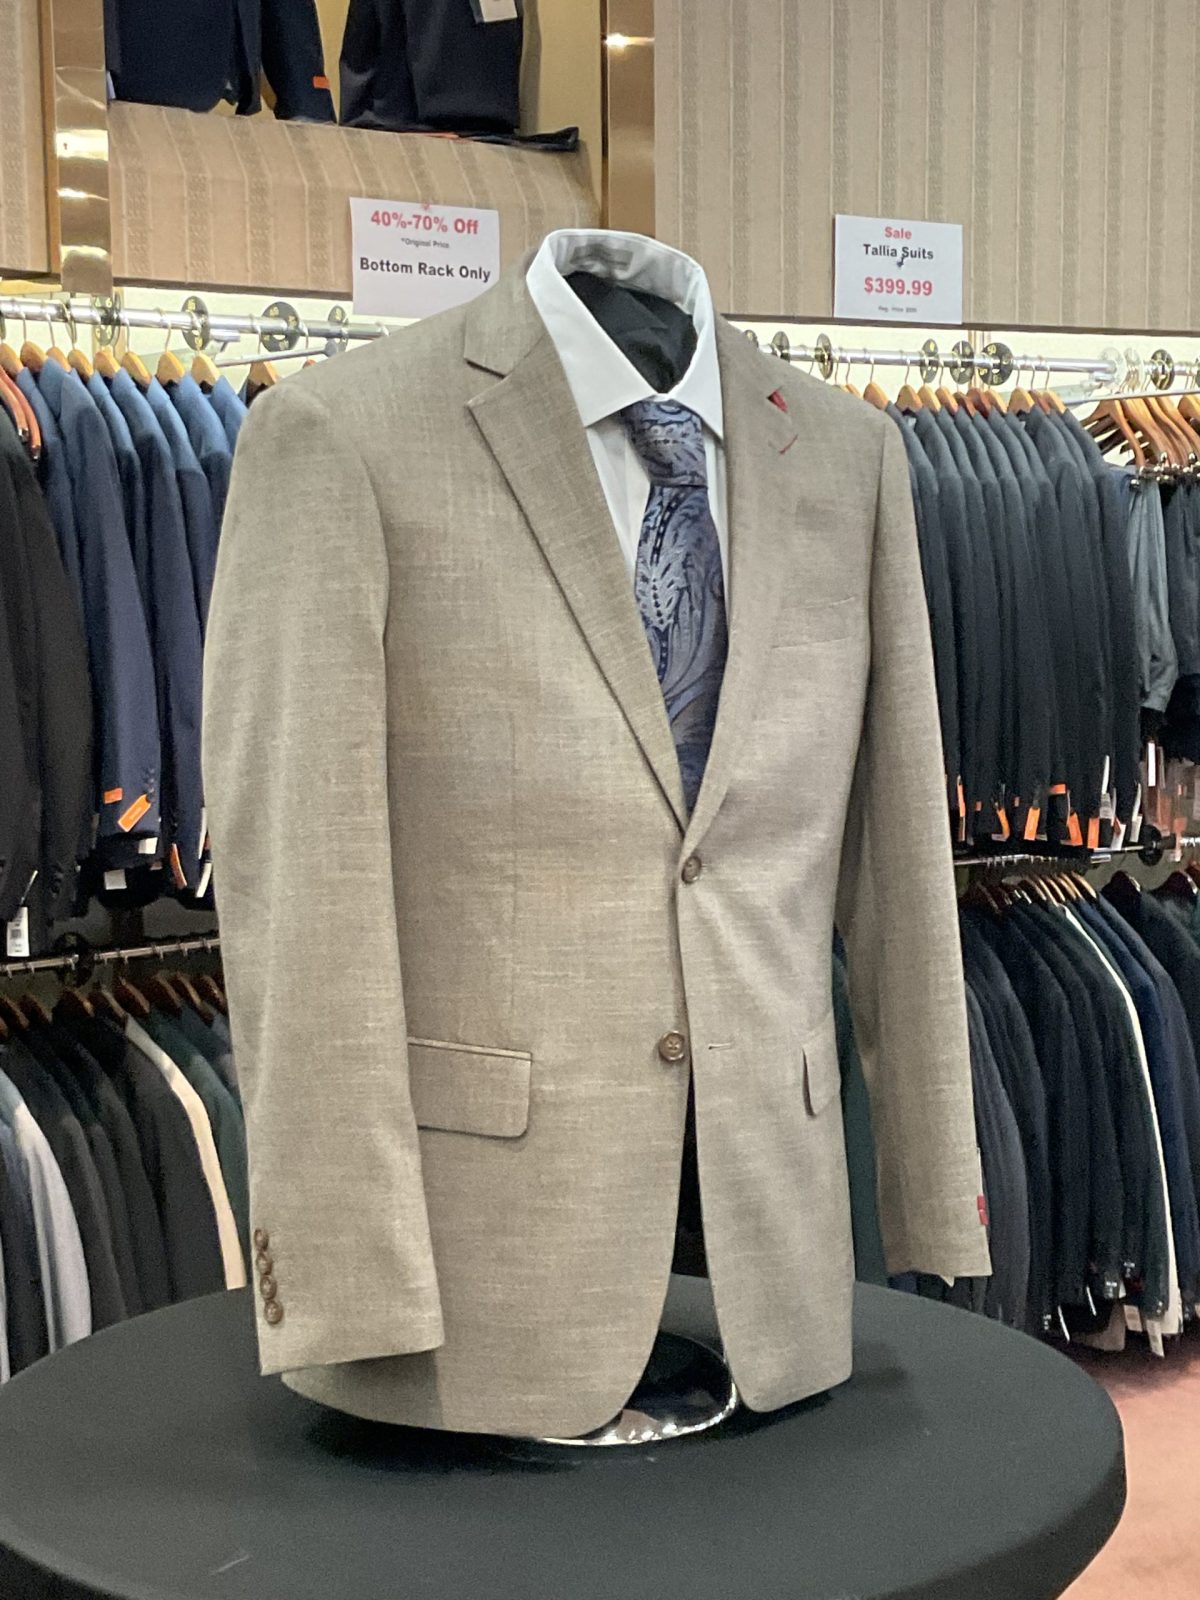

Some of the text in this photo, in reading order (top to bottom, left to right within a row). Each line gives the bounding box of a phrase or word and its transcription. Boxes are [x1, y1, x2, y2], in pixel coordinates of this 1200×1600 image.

[370, 210, 479, 234] 40%-70% Off
[884, 226, 912, 240] Sale
[863, 244, 934, 260] Tallia Suits
[360, 257, 491, 283] Bottom Rack Only
[864, 276, 933, 297] $399.99
